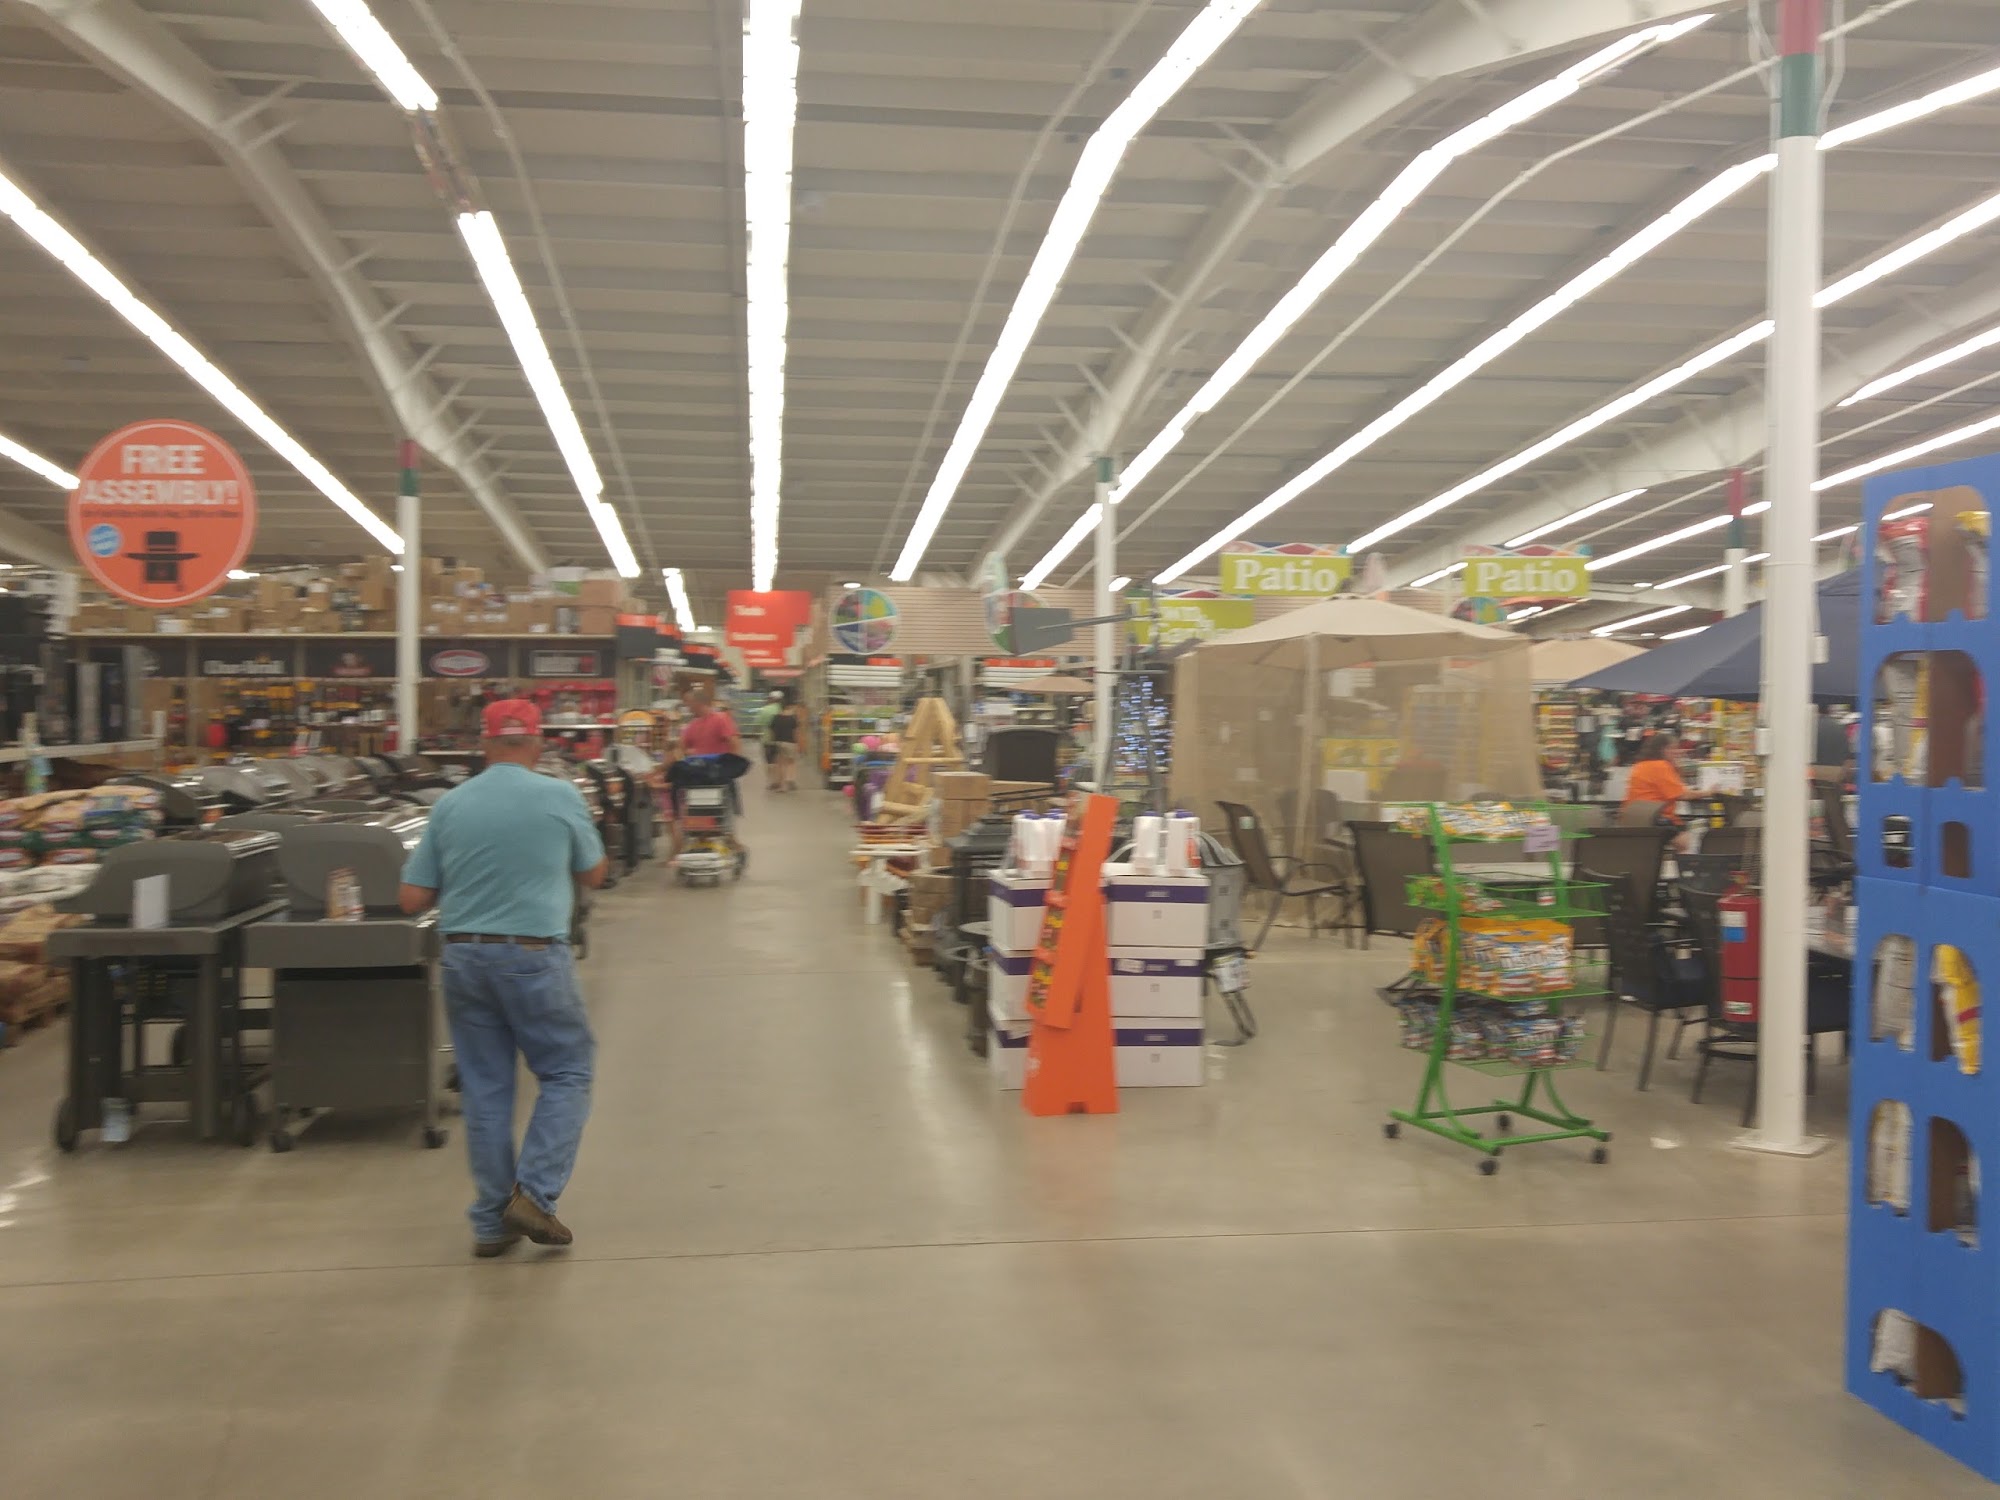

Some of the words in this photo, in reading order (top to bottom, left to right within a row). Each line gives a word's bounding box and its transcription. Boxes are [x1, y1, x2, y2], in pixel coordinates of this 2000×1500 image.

[120, 444, 206, 475] FREE
[1232, 558, 1338, 592] Patio
[1475, 560, 1577, 592] Patio
